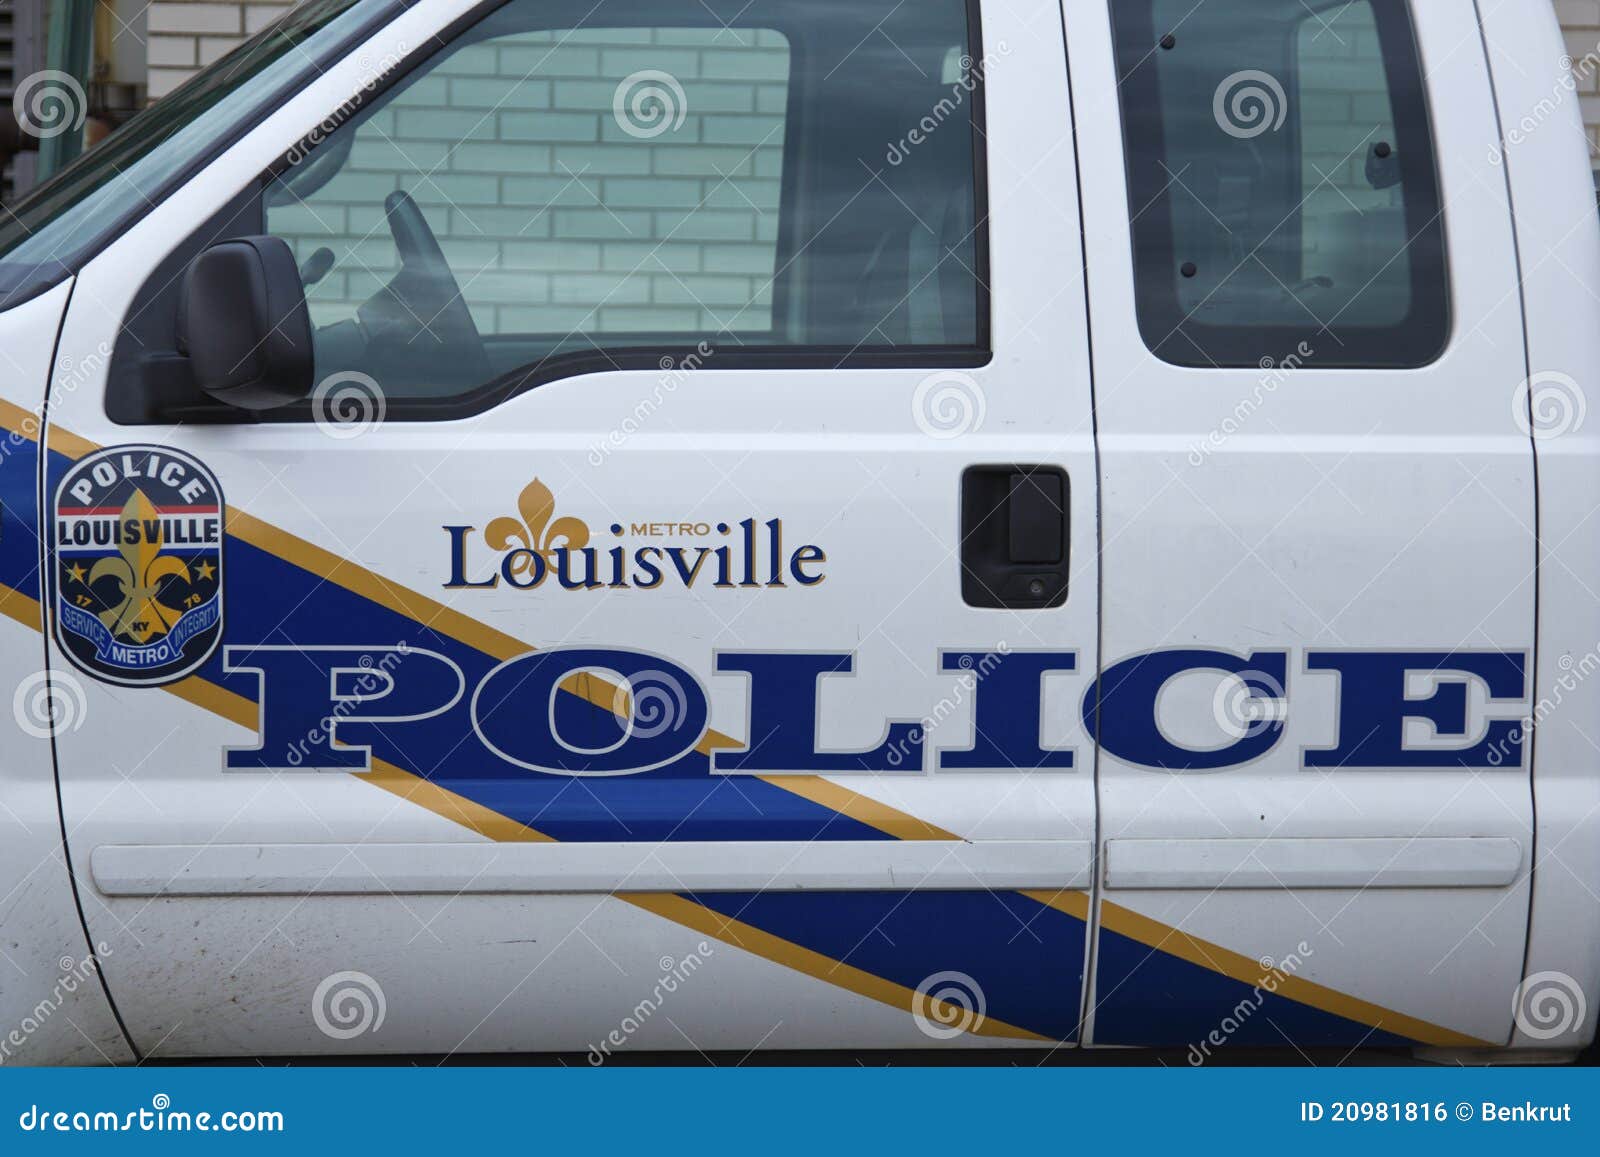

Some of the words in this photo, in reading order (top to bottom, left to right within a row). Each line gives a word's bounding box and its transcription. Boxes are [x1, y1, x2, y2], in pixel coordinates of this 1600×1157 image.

[70, 454, 207, 506] POLICE
[58, 518, 219, 546] LOUISVILLE
[630, 521, 711, 537] METRO
[441, 516, 827, 590] Louisville
[75, 594, 92, 607] 17
[184, 593, 202, 609] 78
[64, 607, 108, 648] SERVICE
[132, 621, 150, 632] KY
[174, 605, 218, 647] INTEGRITY
[112, 646, 169, 664] METRO
[222, 645, 1530, 776] POLICE
